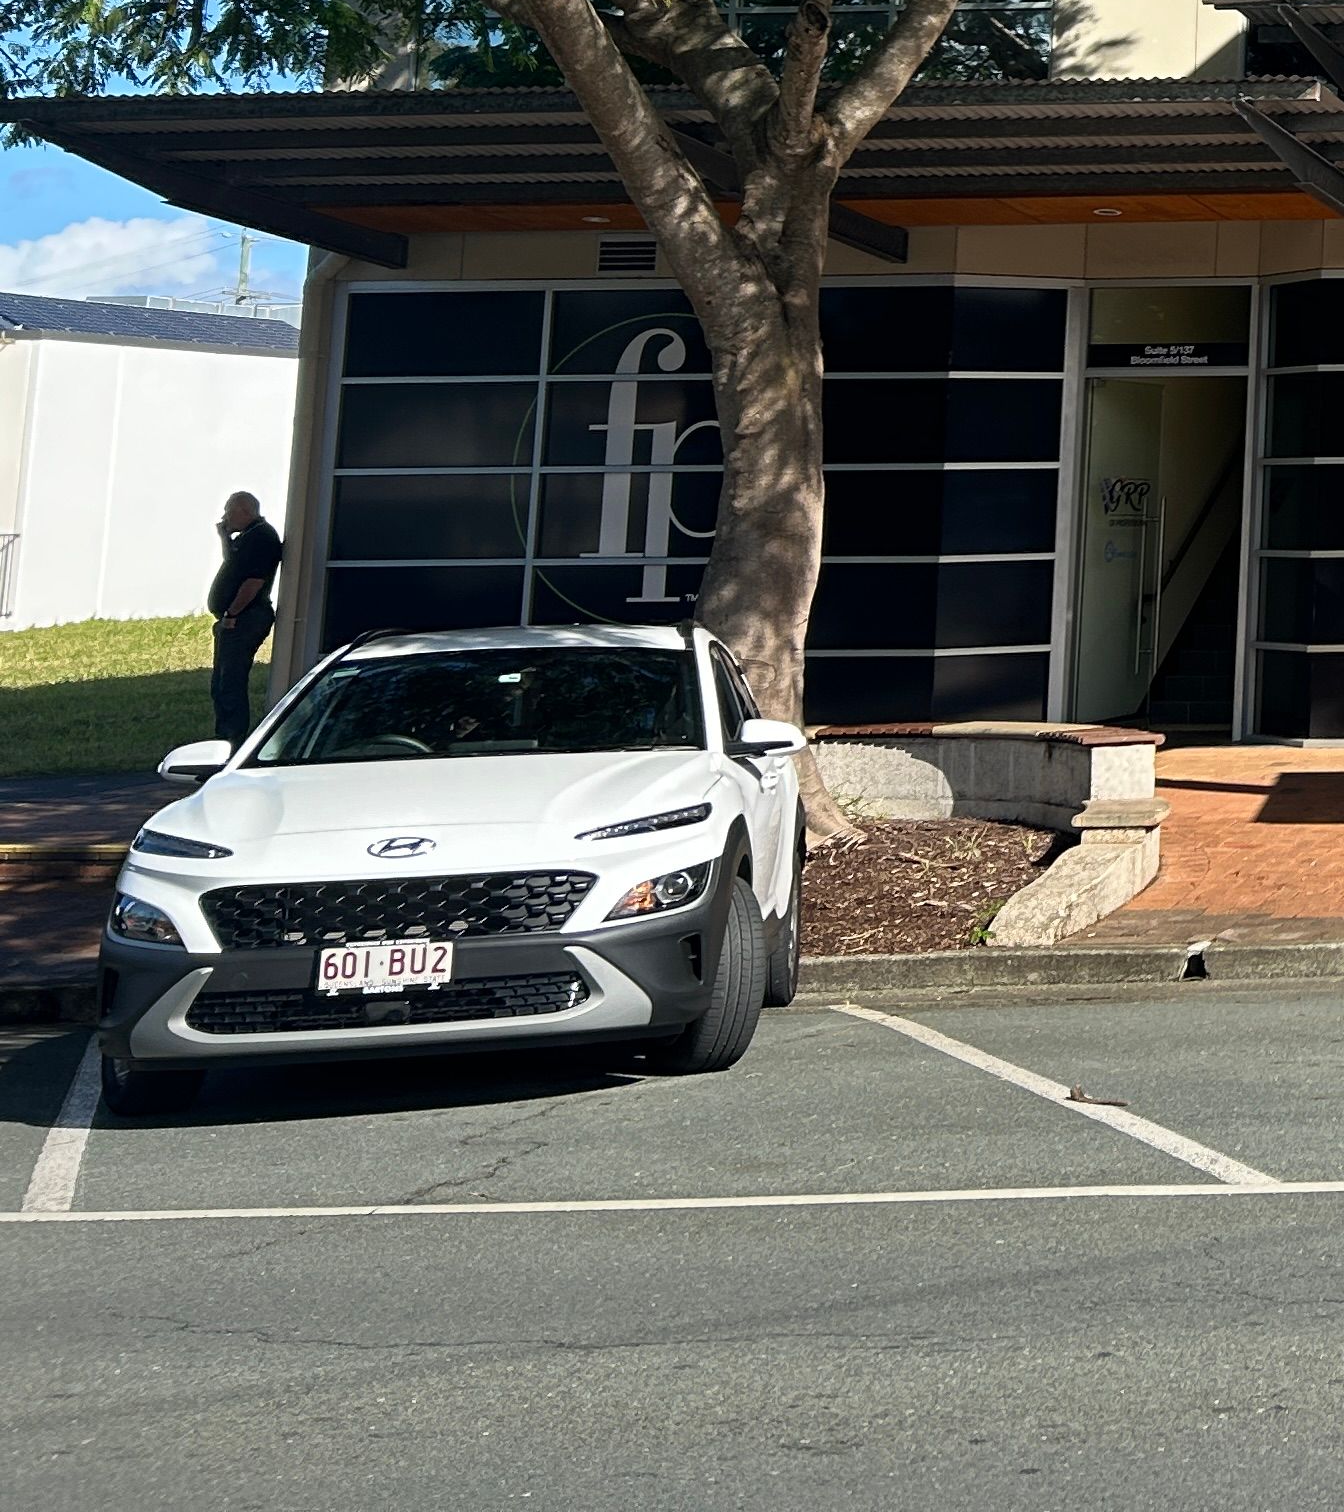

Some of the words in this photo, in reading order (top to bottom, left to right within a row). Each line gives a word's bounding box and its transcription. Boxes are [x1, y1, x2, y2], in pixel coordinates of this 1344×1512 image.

[1144, 345, 1168, 355] Suite
[1130, 355, 1179, 365] Bloomfield
[1180, 355, 1208, 364] Street
